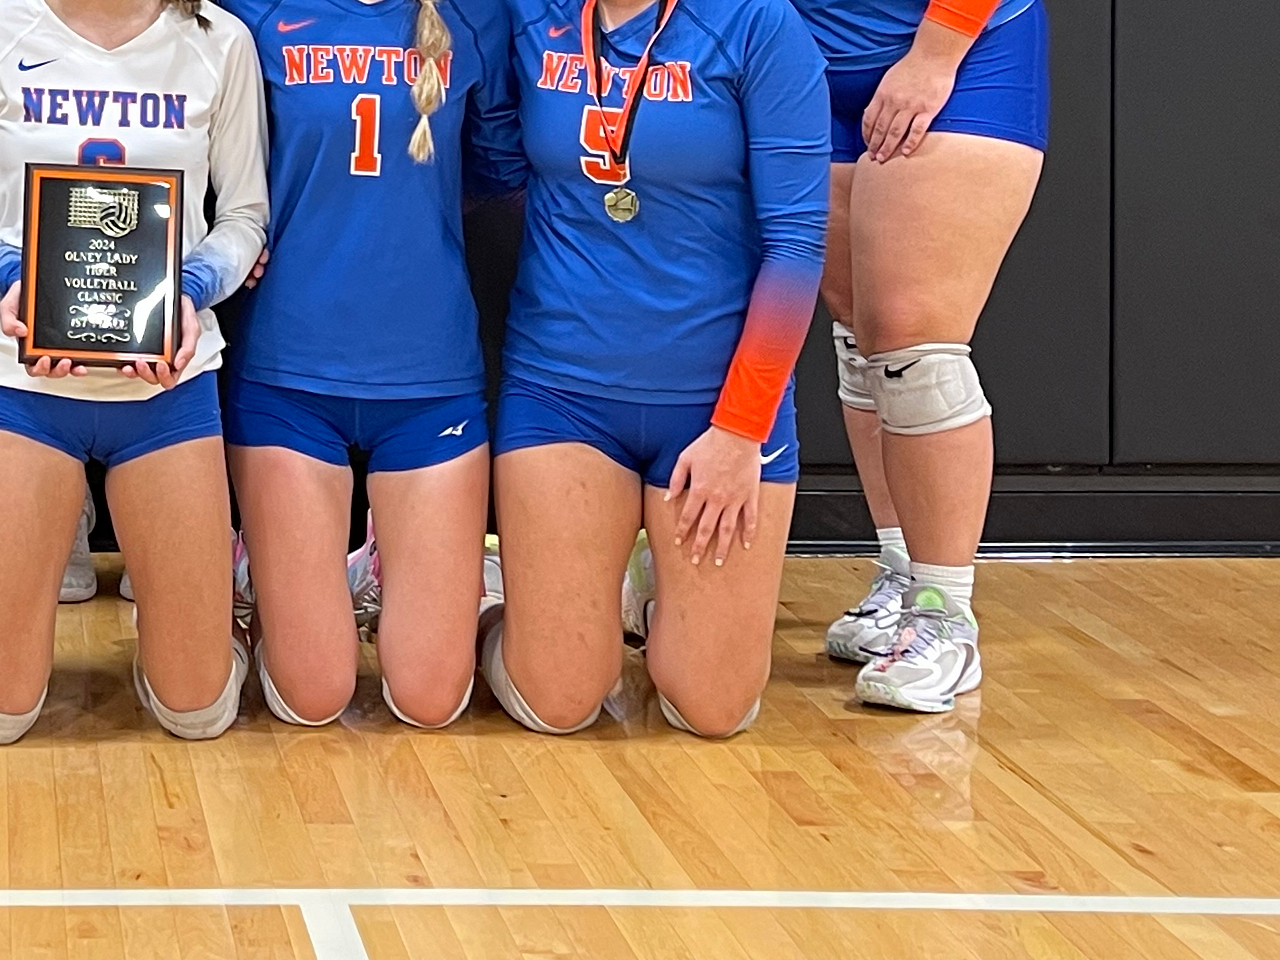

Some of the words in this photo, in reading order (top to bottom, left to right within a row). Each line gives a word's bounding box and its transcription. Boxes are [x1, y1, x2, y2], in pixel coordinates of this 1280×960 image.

[21, 86, 188, 130] NEWTON
[349, 93, 382, 177] 1
[88, 238, 116, 250] 2024
[64, 250, 103, 263] OLNEY
[106, 251, 139, 265] LADY
[84, 263, 118, 277] TIGER
[64, 277, 138, 291] VOLLEYBALL
[77, 291, 124, 304] CLASSIC
